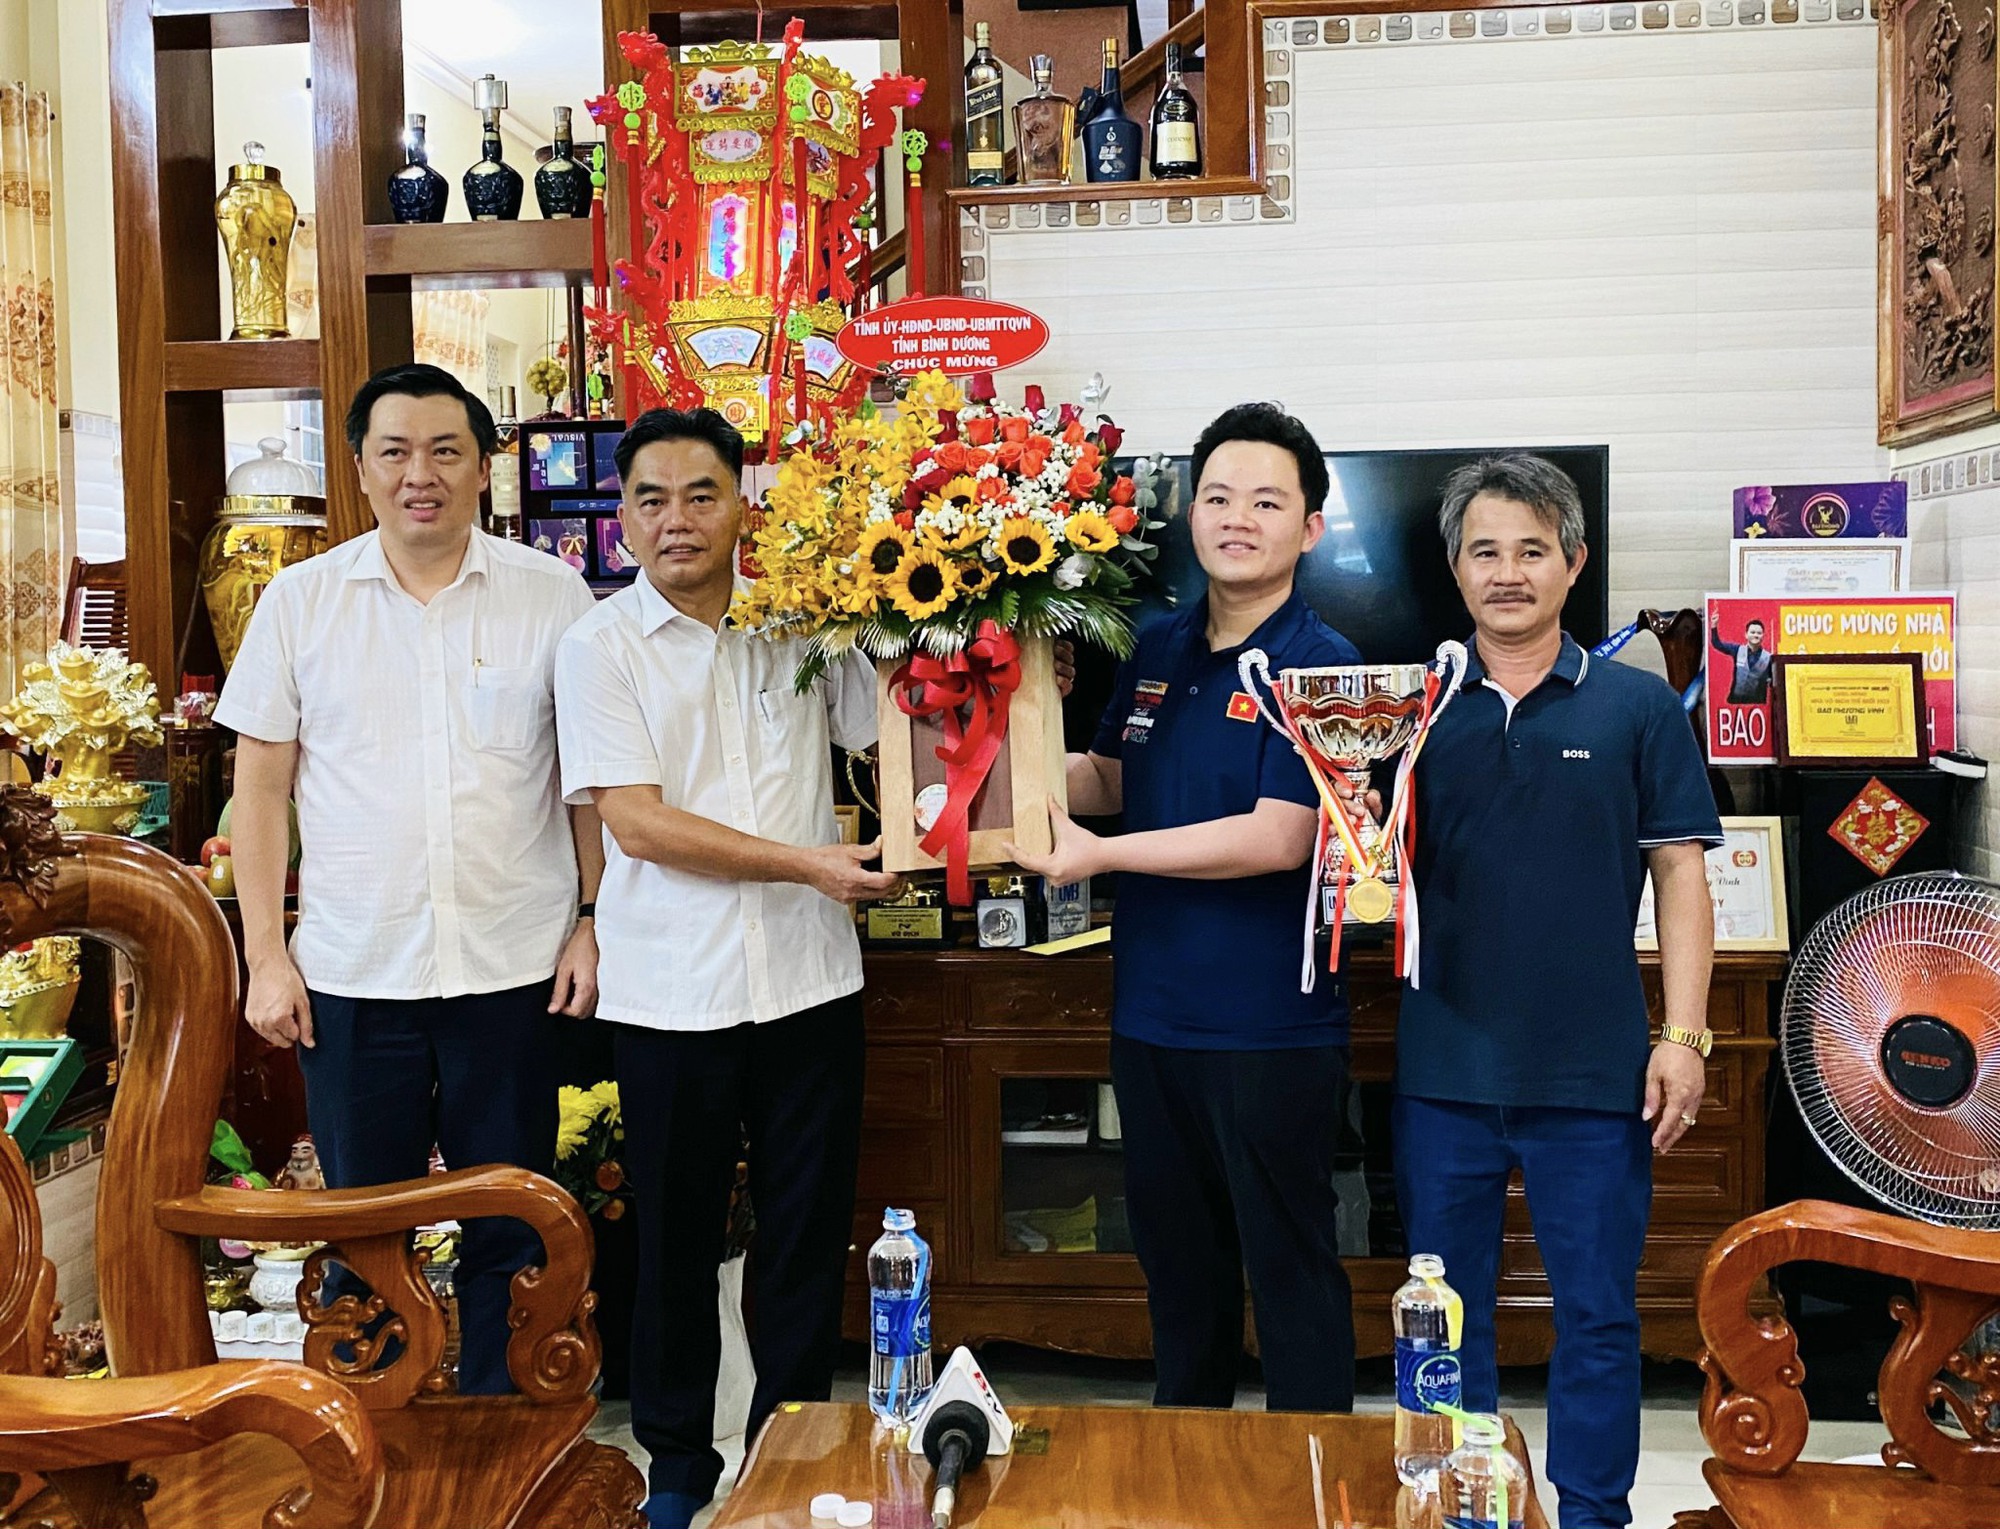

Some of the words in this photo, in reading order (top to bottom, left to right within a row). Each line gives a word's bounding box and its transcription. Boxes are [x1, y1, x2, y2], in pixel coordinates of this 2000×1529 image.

[854, 318, 879, 336] TỈNH
[883, 316, 1031, 335] ỦY-HĐND-UBND-UBMTTQVN
[892, 336, 918, 354] TỈNH
[922, 336, 948, 351] BÌNH
[952, 336, 990, 351] DƯƠNG
[891, 355, 940, 371] CHÚC
[946, 354, 998, 368] MỪNG
[551, 433, 585, 442] VISUAL
[1785, 610, 1833, 635] CHÚC
[1840, 609, 1898, 635] MỪNG
[1905, 607, 1945, 635] NHÀ
[1719, 708, 1766, 746] BAO
[1562, 749, 1591, 759] BOSS
[1417, 1372, 1460, 1389] AQUAFIN
